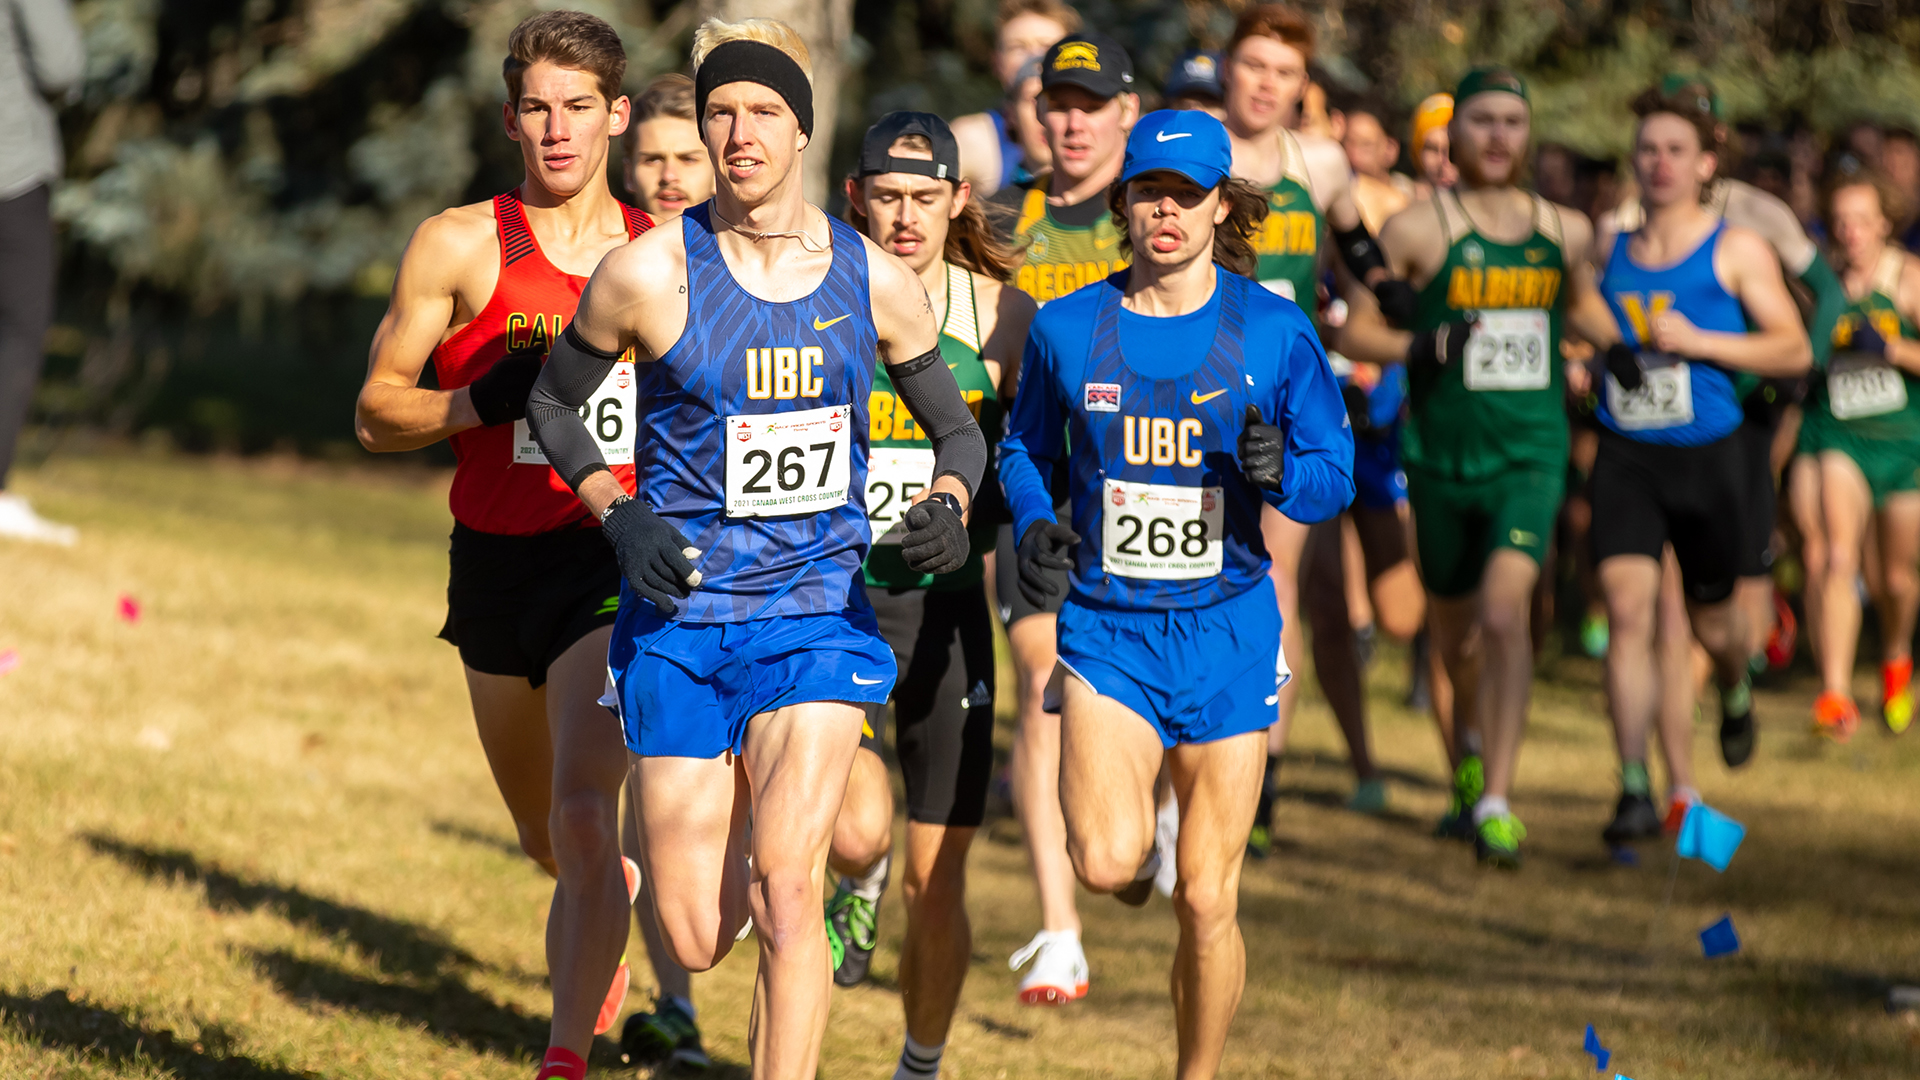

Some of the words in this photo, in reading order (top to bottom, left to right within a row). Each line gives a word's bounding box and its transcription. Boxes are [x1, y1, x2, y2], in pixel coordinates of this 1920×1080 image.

[746, 346, 824, 400] UBC
[520, 446, 536, 454] 2021
[1124, 415, 1203, 468] UBC
[742, 441, 836, 494] 267
[752, 498, 778, 507] CANADA
[779, 496, 796, 505] WEST
[797, 493, 817, 503] CROSS
[818, 489, 844, 500] COUNTRY
[1116, 514, 1209, 558] 268
